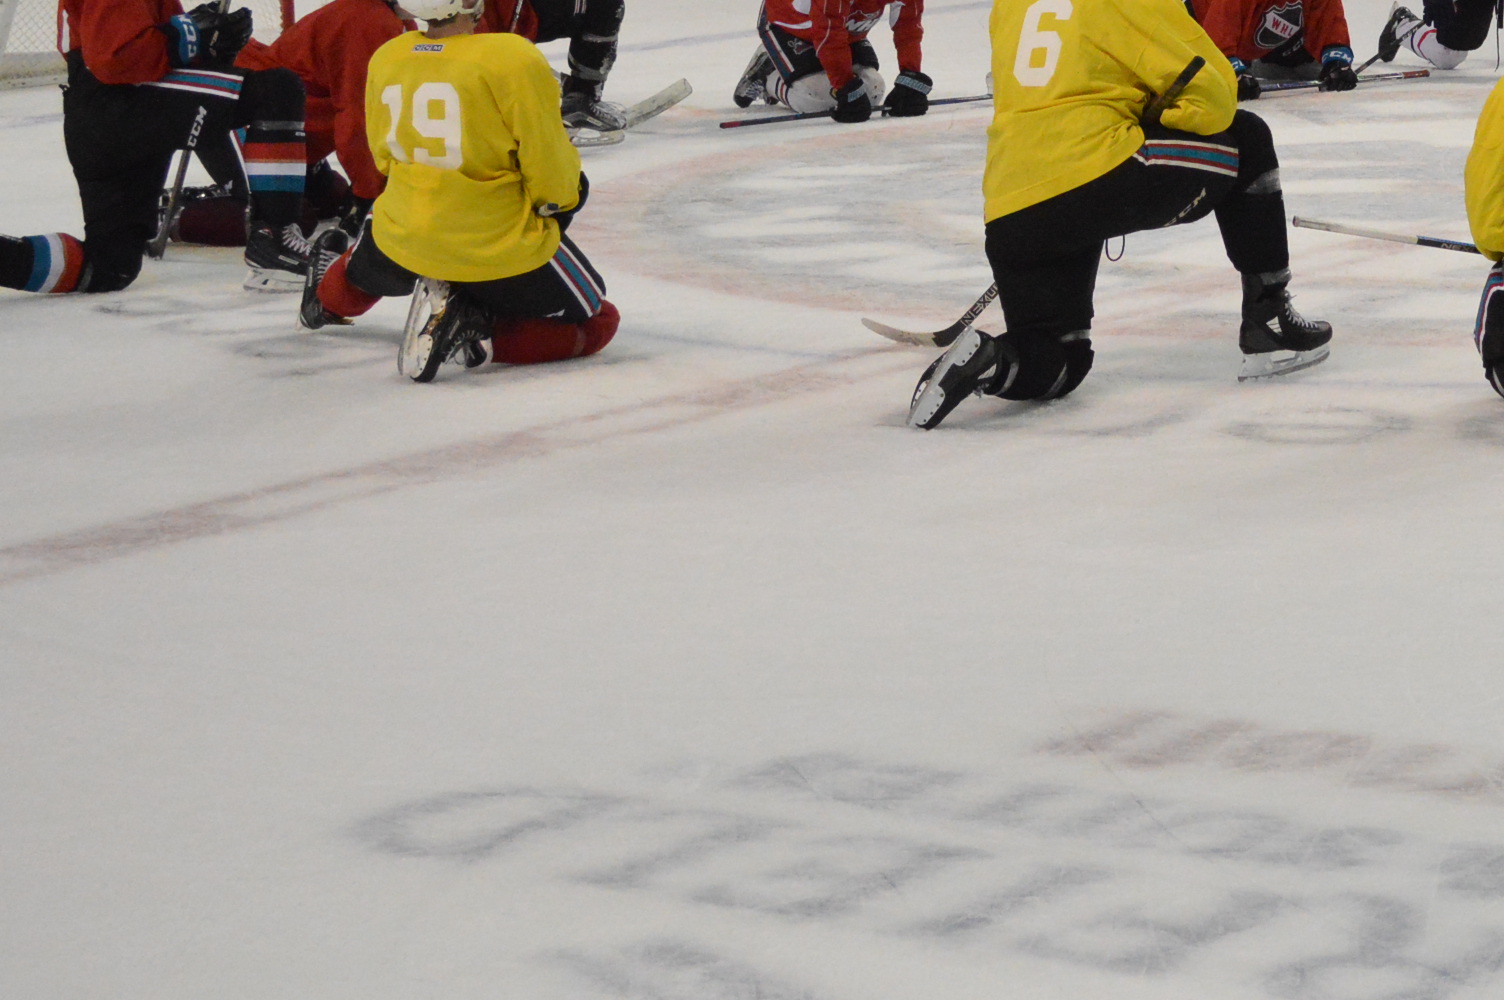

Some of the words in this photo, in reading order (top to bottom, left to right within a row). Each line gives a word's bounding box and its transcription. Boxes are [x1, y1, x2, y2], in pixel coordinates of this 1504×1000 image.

[1271, 17, 1294, 39] WHL
[412, 44, 444, 52] CCM
[187, 105, 208, 148] CCM
[381, 82, 463, 170] 19
